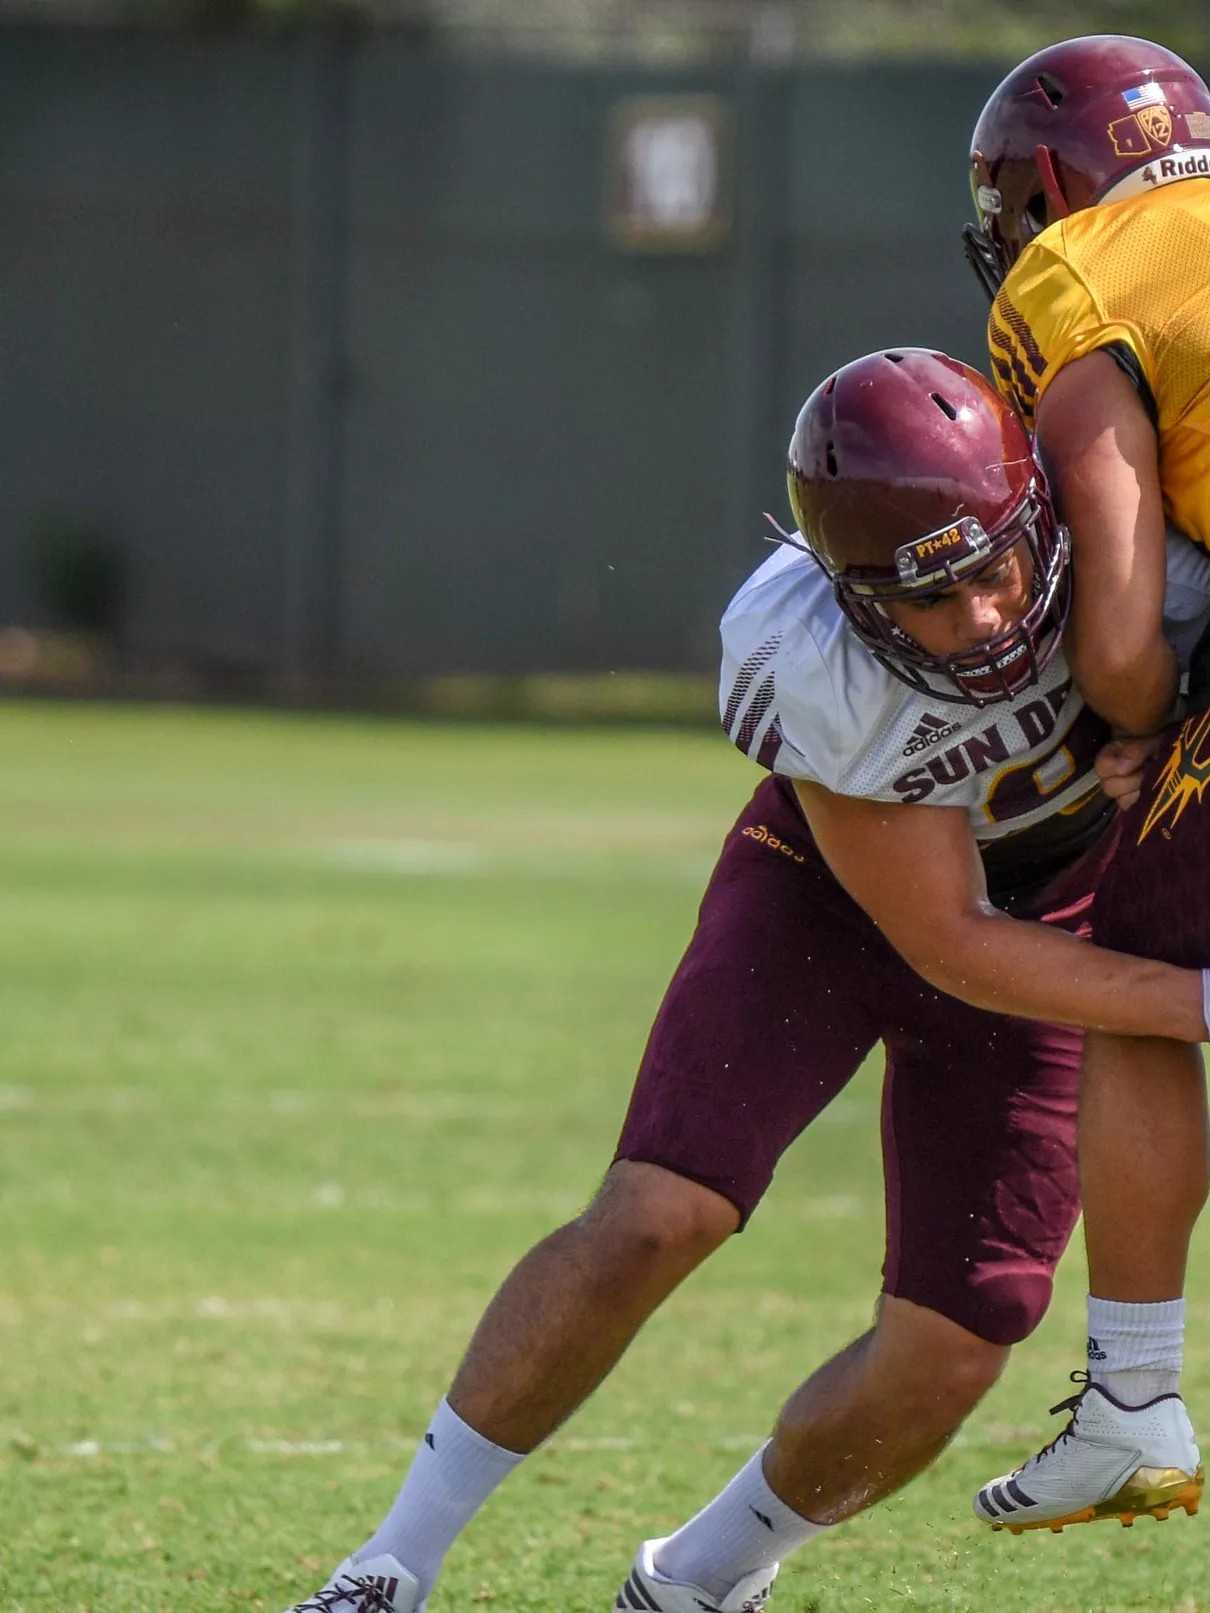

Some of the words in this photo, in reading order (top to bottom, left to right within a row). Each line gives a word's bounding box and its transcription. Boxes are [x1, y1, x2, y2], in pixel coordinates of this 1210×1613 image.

[1152, 122, 1169, 138] 12
[902, 721, 962, 757] adidas
[892, 722, 1011, 804] SUN
